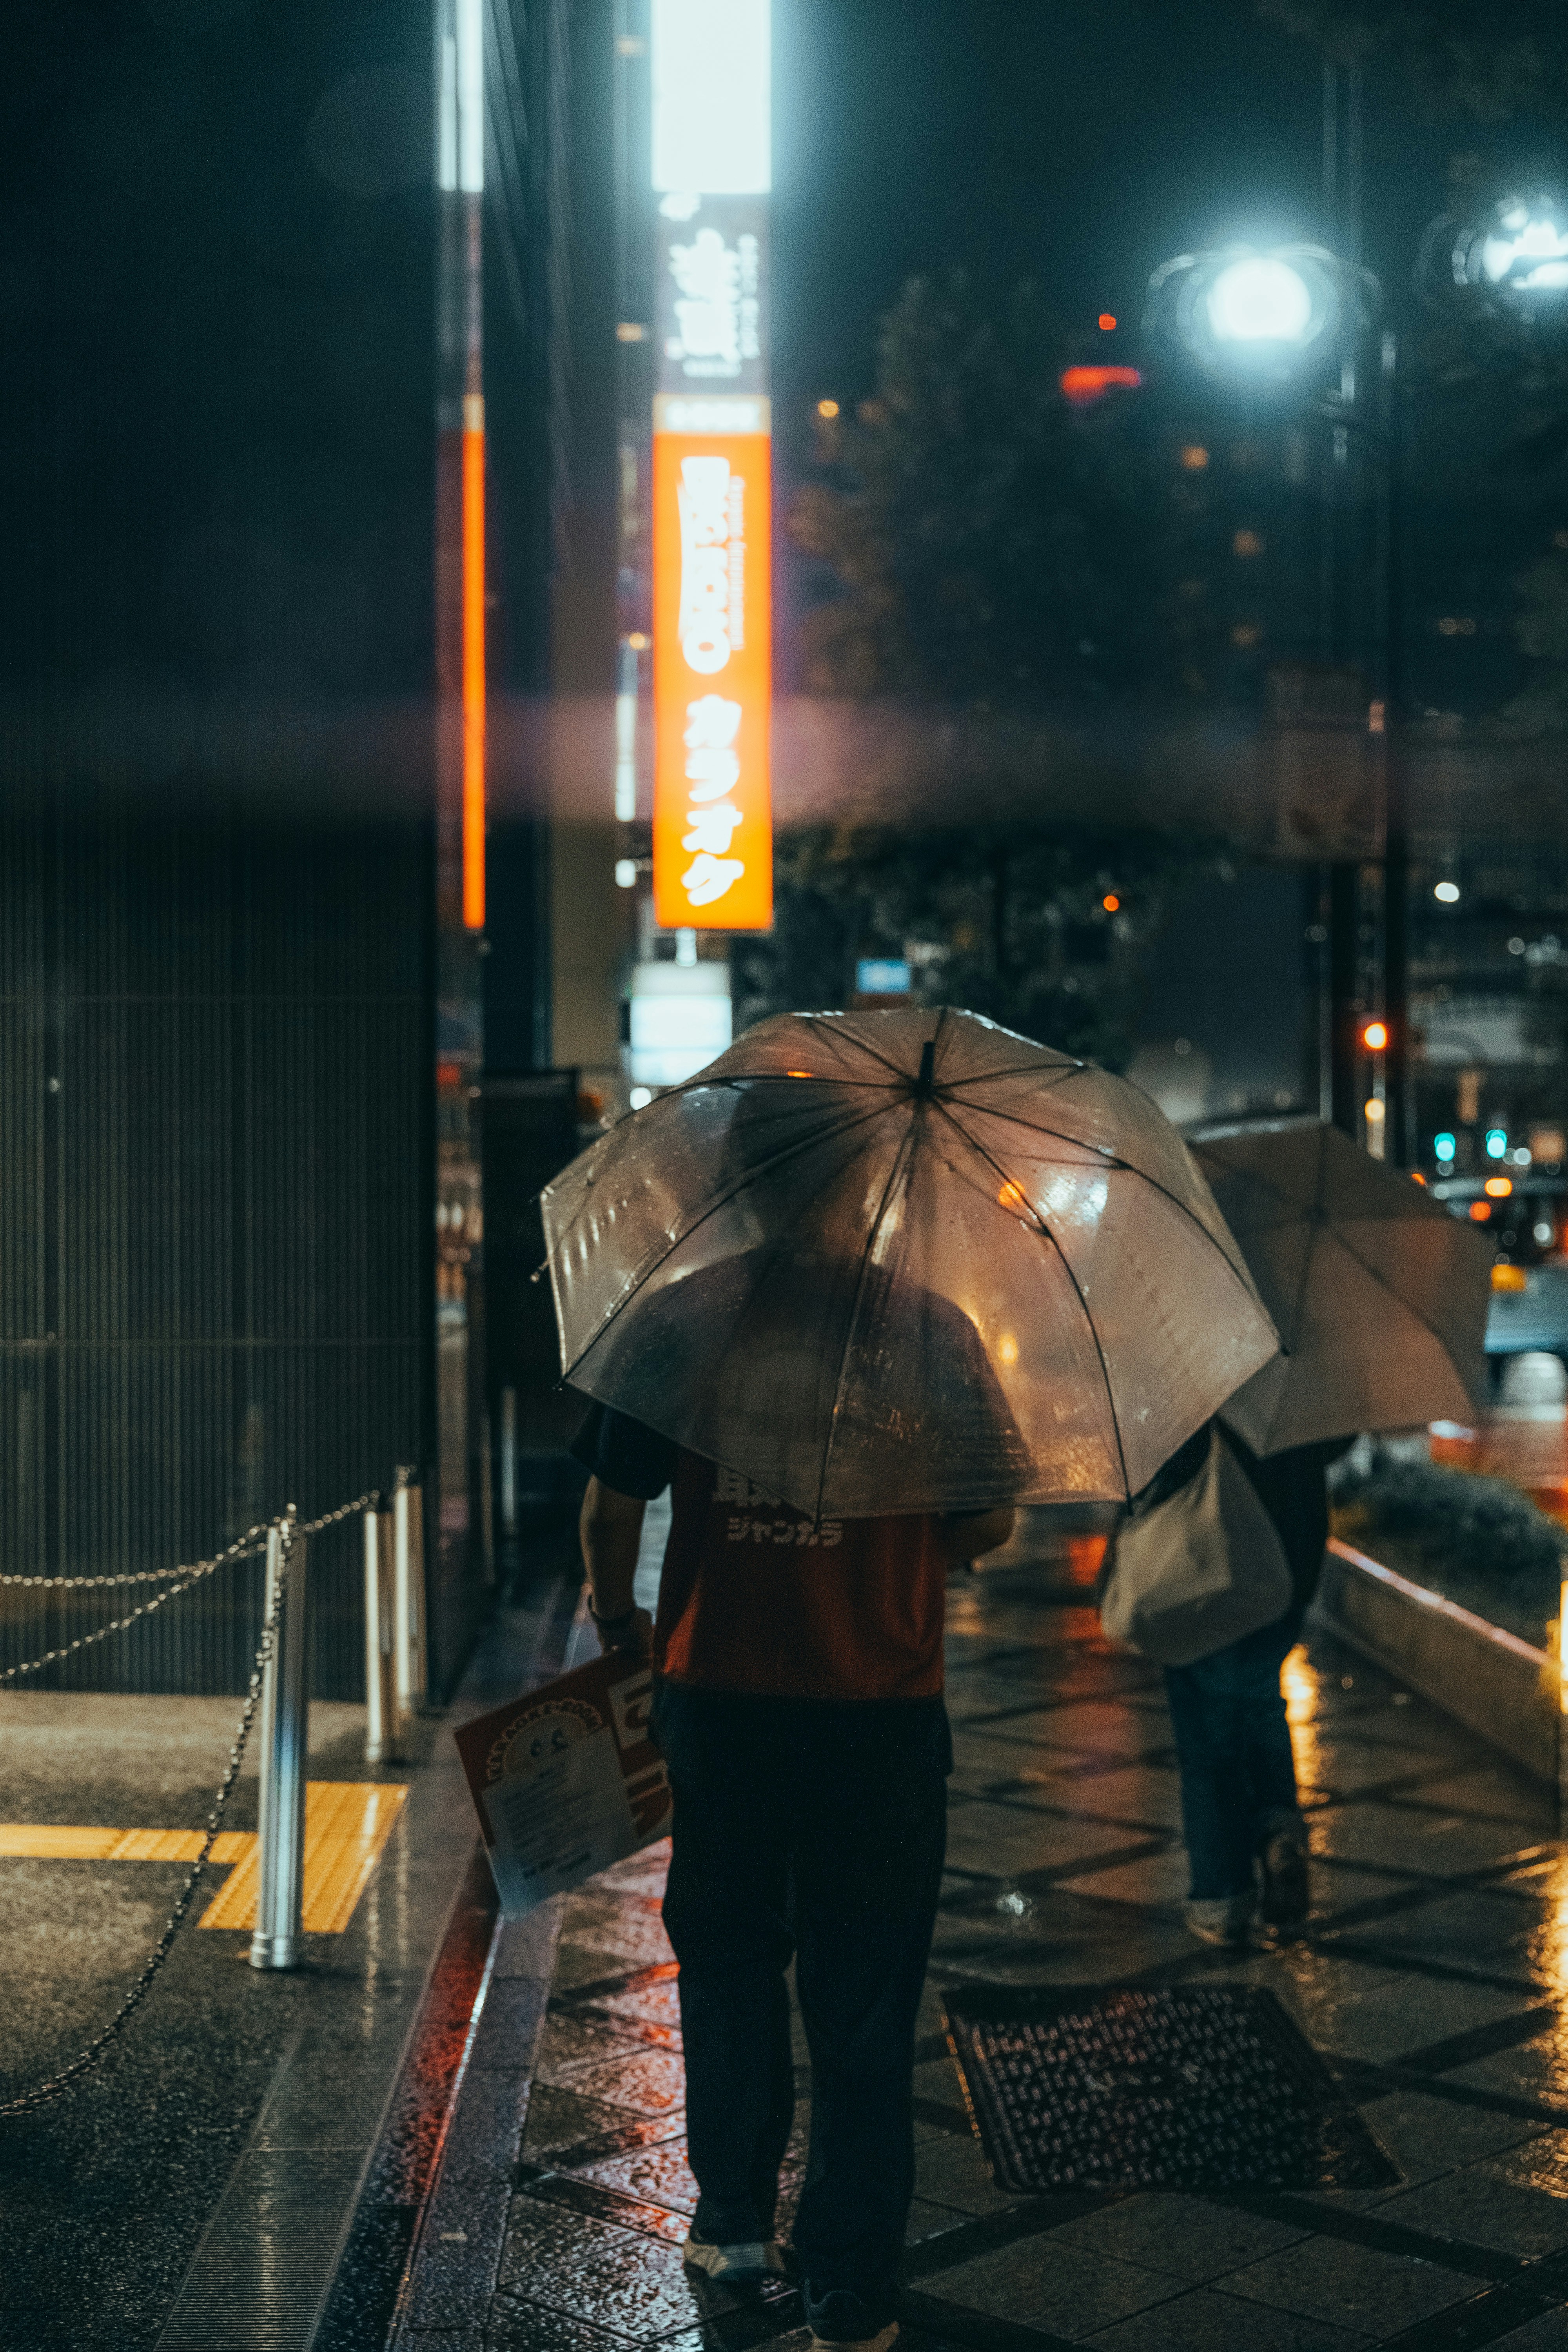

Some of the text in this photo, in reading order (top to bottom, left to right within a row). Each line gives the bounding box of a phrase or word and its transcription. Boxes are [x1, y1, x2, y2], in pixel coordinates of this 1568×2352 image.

[681, 694, 745, 907] カラオケ
[728, 1515, 843, 1547] ジャンカラ
